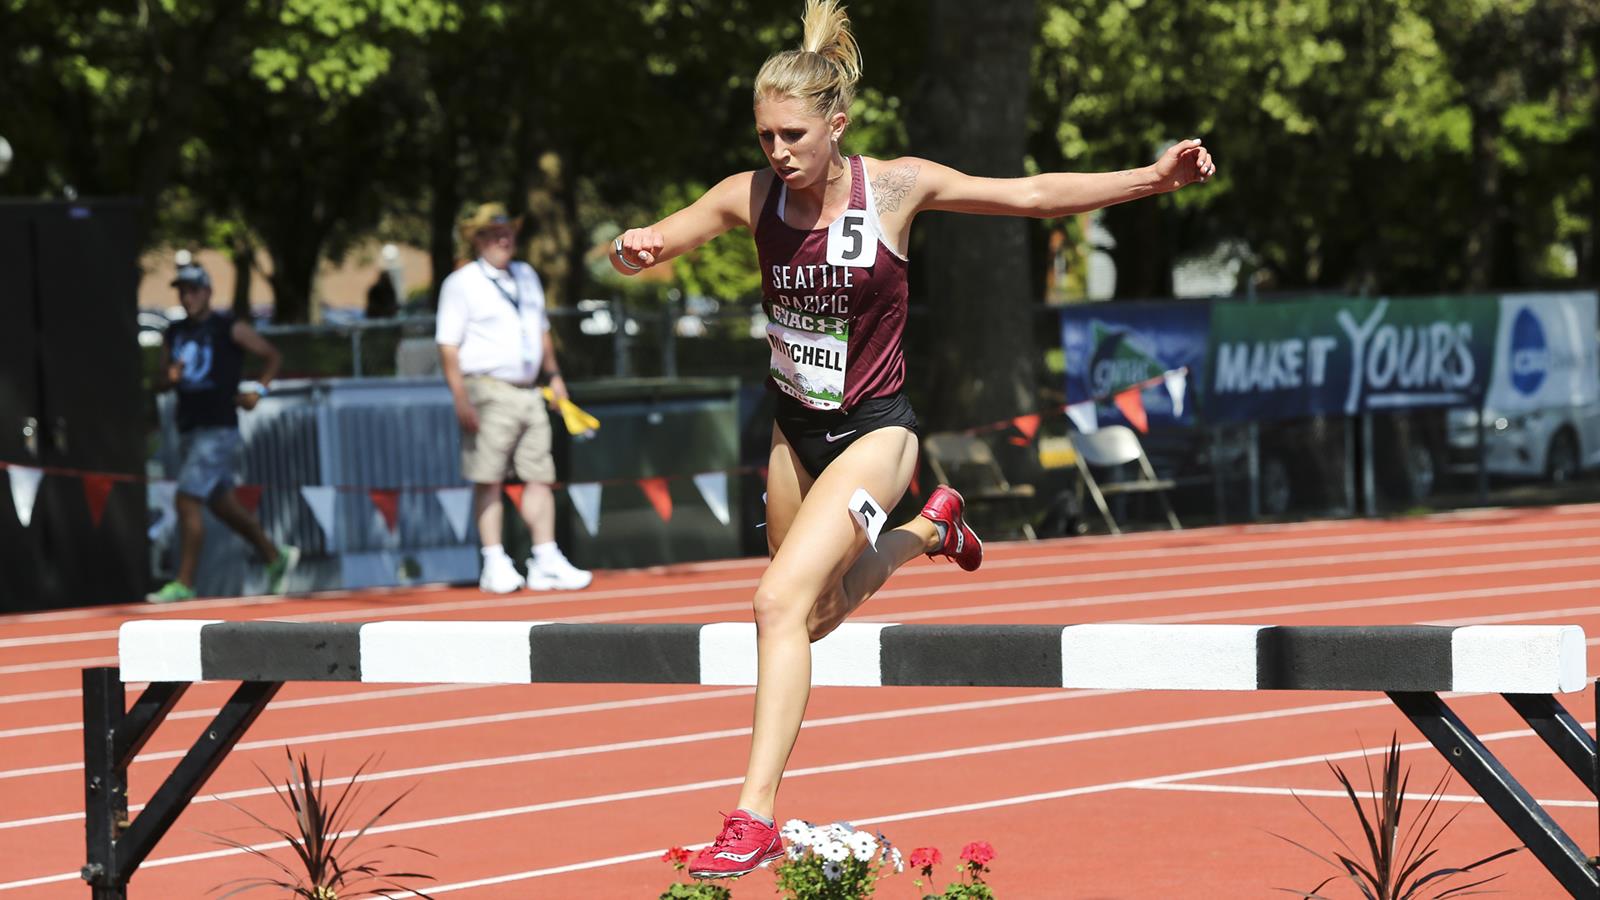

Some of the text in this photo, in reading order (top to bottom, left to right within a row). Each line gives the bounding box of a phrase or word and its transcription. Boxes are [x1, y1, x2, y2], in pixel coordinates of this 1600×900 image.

[841, 216, 864, 260] 5
[772, 264, 854, 290] SEATTLE
[767, 332, 843, 373] MITCHELL
[1214, 338, 1304, 395] MAKE
[1336, 297, 1476, 416] YOURS
